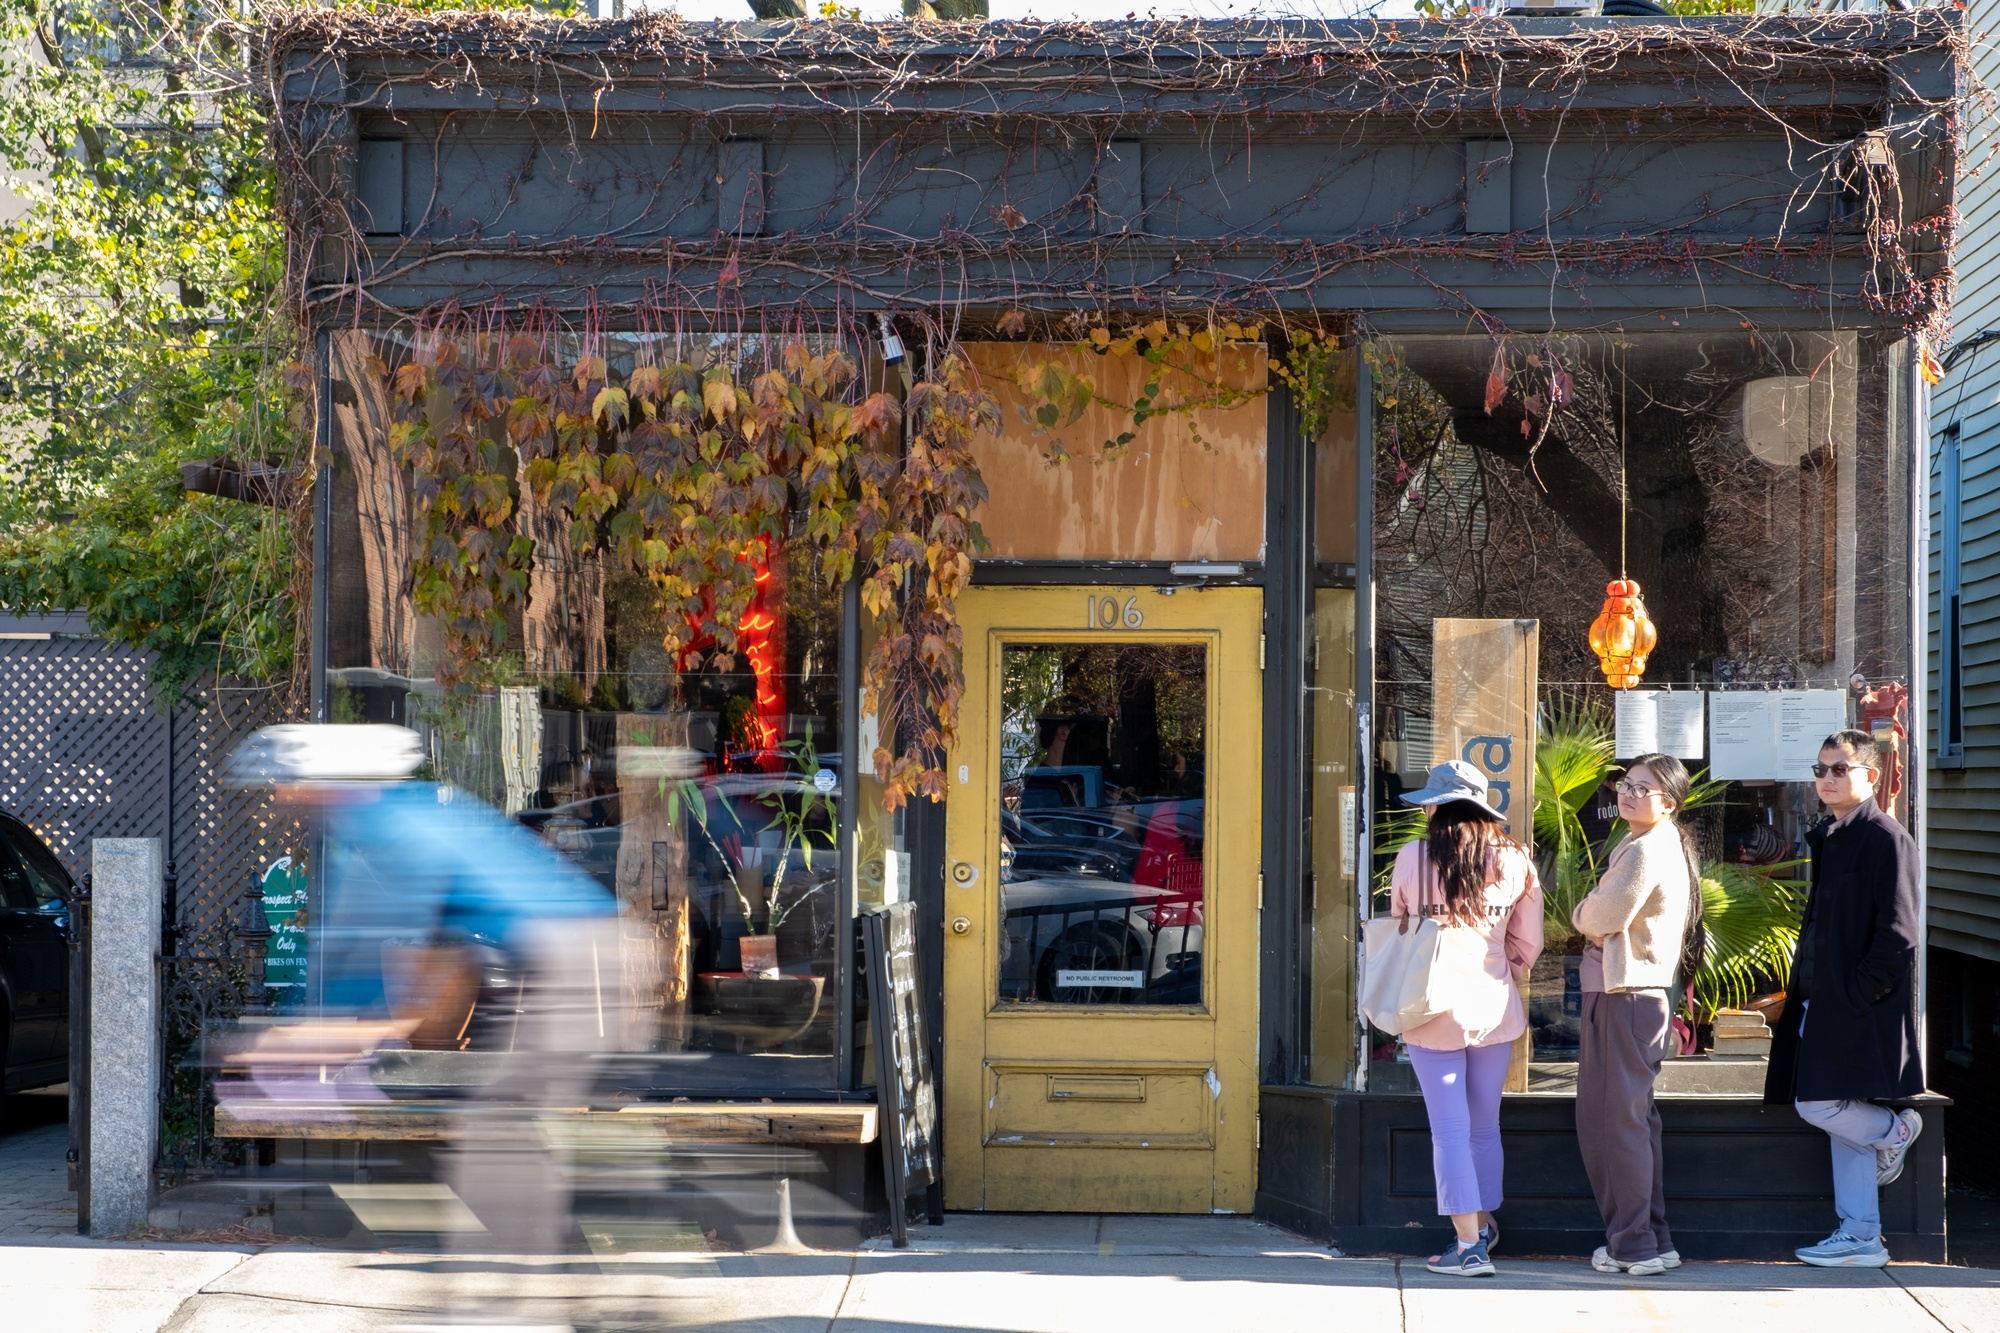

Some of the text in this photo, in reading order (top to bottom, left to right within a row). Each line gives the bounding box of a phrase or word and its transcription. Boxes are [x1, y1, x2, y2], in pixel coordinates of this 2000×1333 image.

[1088, 594, 1144, 629] 106
[276, 936, 297, 953] Only
[267, 957, 285, 966] BIKES
[285, 957, 295, 966] ON
[295, 957, 308, 966] FEN
